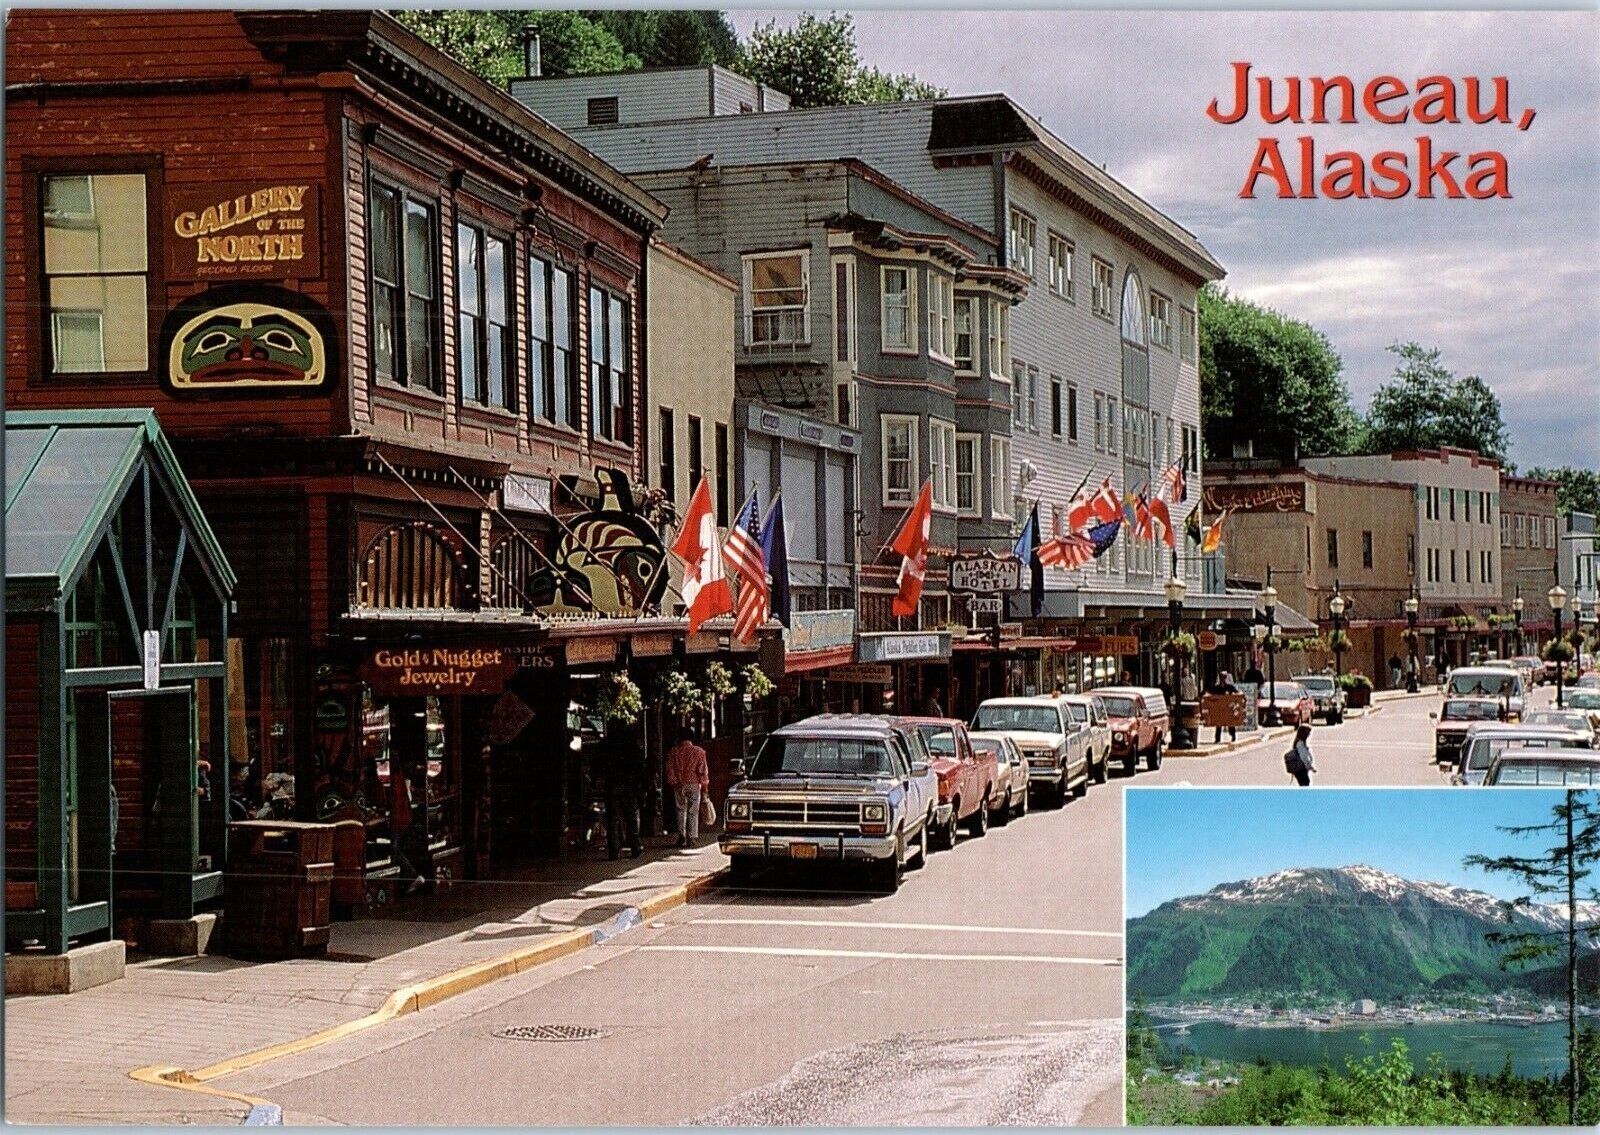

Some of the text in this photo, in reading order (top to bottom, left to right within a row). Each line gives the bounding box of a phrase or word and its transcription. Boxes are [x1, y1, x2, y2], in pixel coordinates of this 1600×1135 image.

[174, 185, 309, 238] GALLERY
[256, 218, 305, 231] OF THE
[197, 234, 304, 262] NORTH
[240, 264, 274, 274] FLOOR
[955, 561, 1017, 572] ALASKAN
[961, 577, 1011, 590] HOTEL
[971, 600, 998, 611] BAR
[1105, 641, 1135, 652] FURS
[375, 649, 502, 668] Gold Nugget
[400, 668, 476, 686] Jewelry
